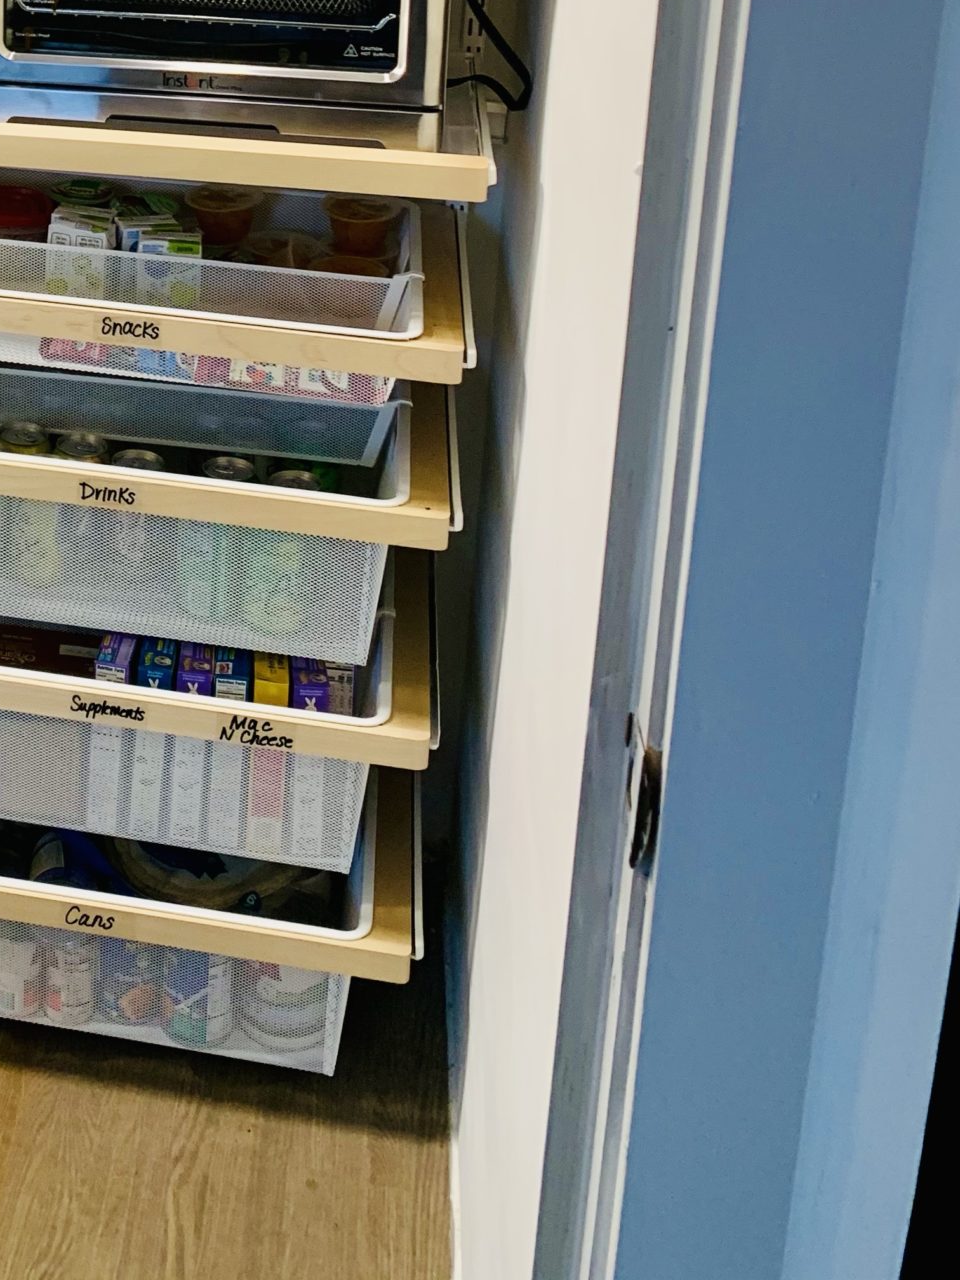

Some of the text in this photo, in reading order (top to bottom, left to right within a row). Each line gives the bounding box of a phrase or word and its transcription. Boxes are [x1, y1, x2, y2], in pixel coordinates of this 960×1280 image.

[101, 316, 160, 340] Snacks
[79, 481, 136, 505] Drinks
[70, 694, 146, 722] Supplements
[229, 714, 274, 732] Mac
[219, 727, 294, 749] N Cheese
[64, 905, 116, 930] Cans
